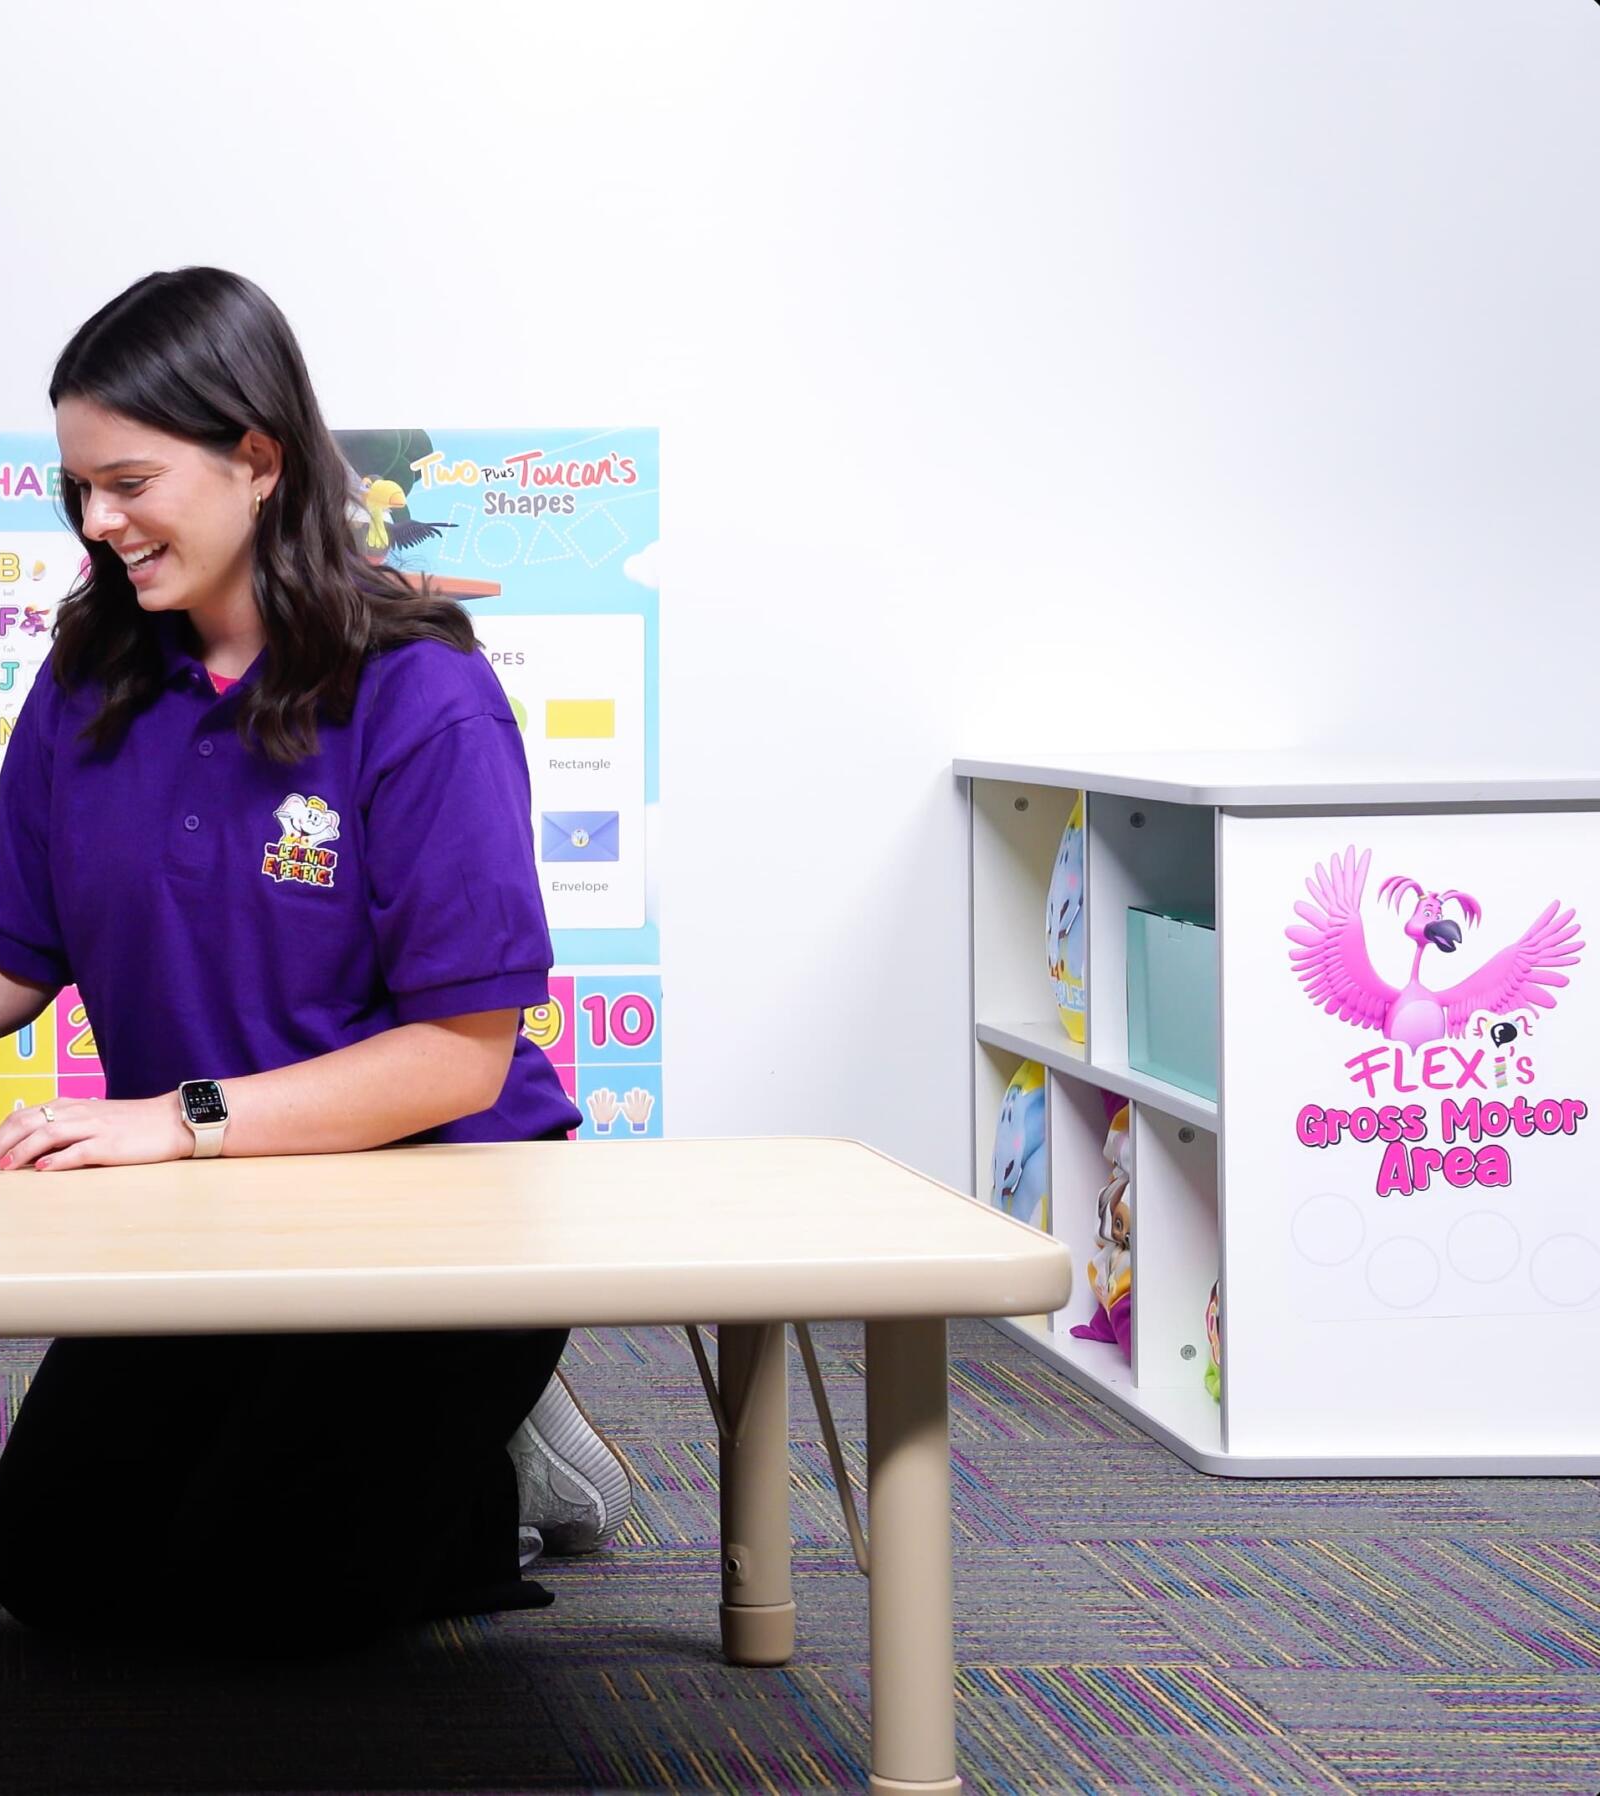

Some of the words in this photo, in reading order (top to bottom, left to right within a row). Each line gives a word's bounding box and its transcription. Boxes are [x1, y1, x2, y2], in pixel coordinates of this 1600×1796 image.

[412, 453, 478, 488] Two
[484, 491, 575, 517] Shapes
[0, 607, 19, 636] F
[491, 652, 525, 665] PES
[549, 759, 611, 771] Rectangle
[552, 881, 609, 893] Envelope
[524, 1000, 562, 1047] 9
[582, 994, 655, 1047] 10
[1296, 1104, 1427, 1148] Gross
[1441, 1096, 1588, 1144] Motor
[1376, 1141, 1512, 1198] Area
